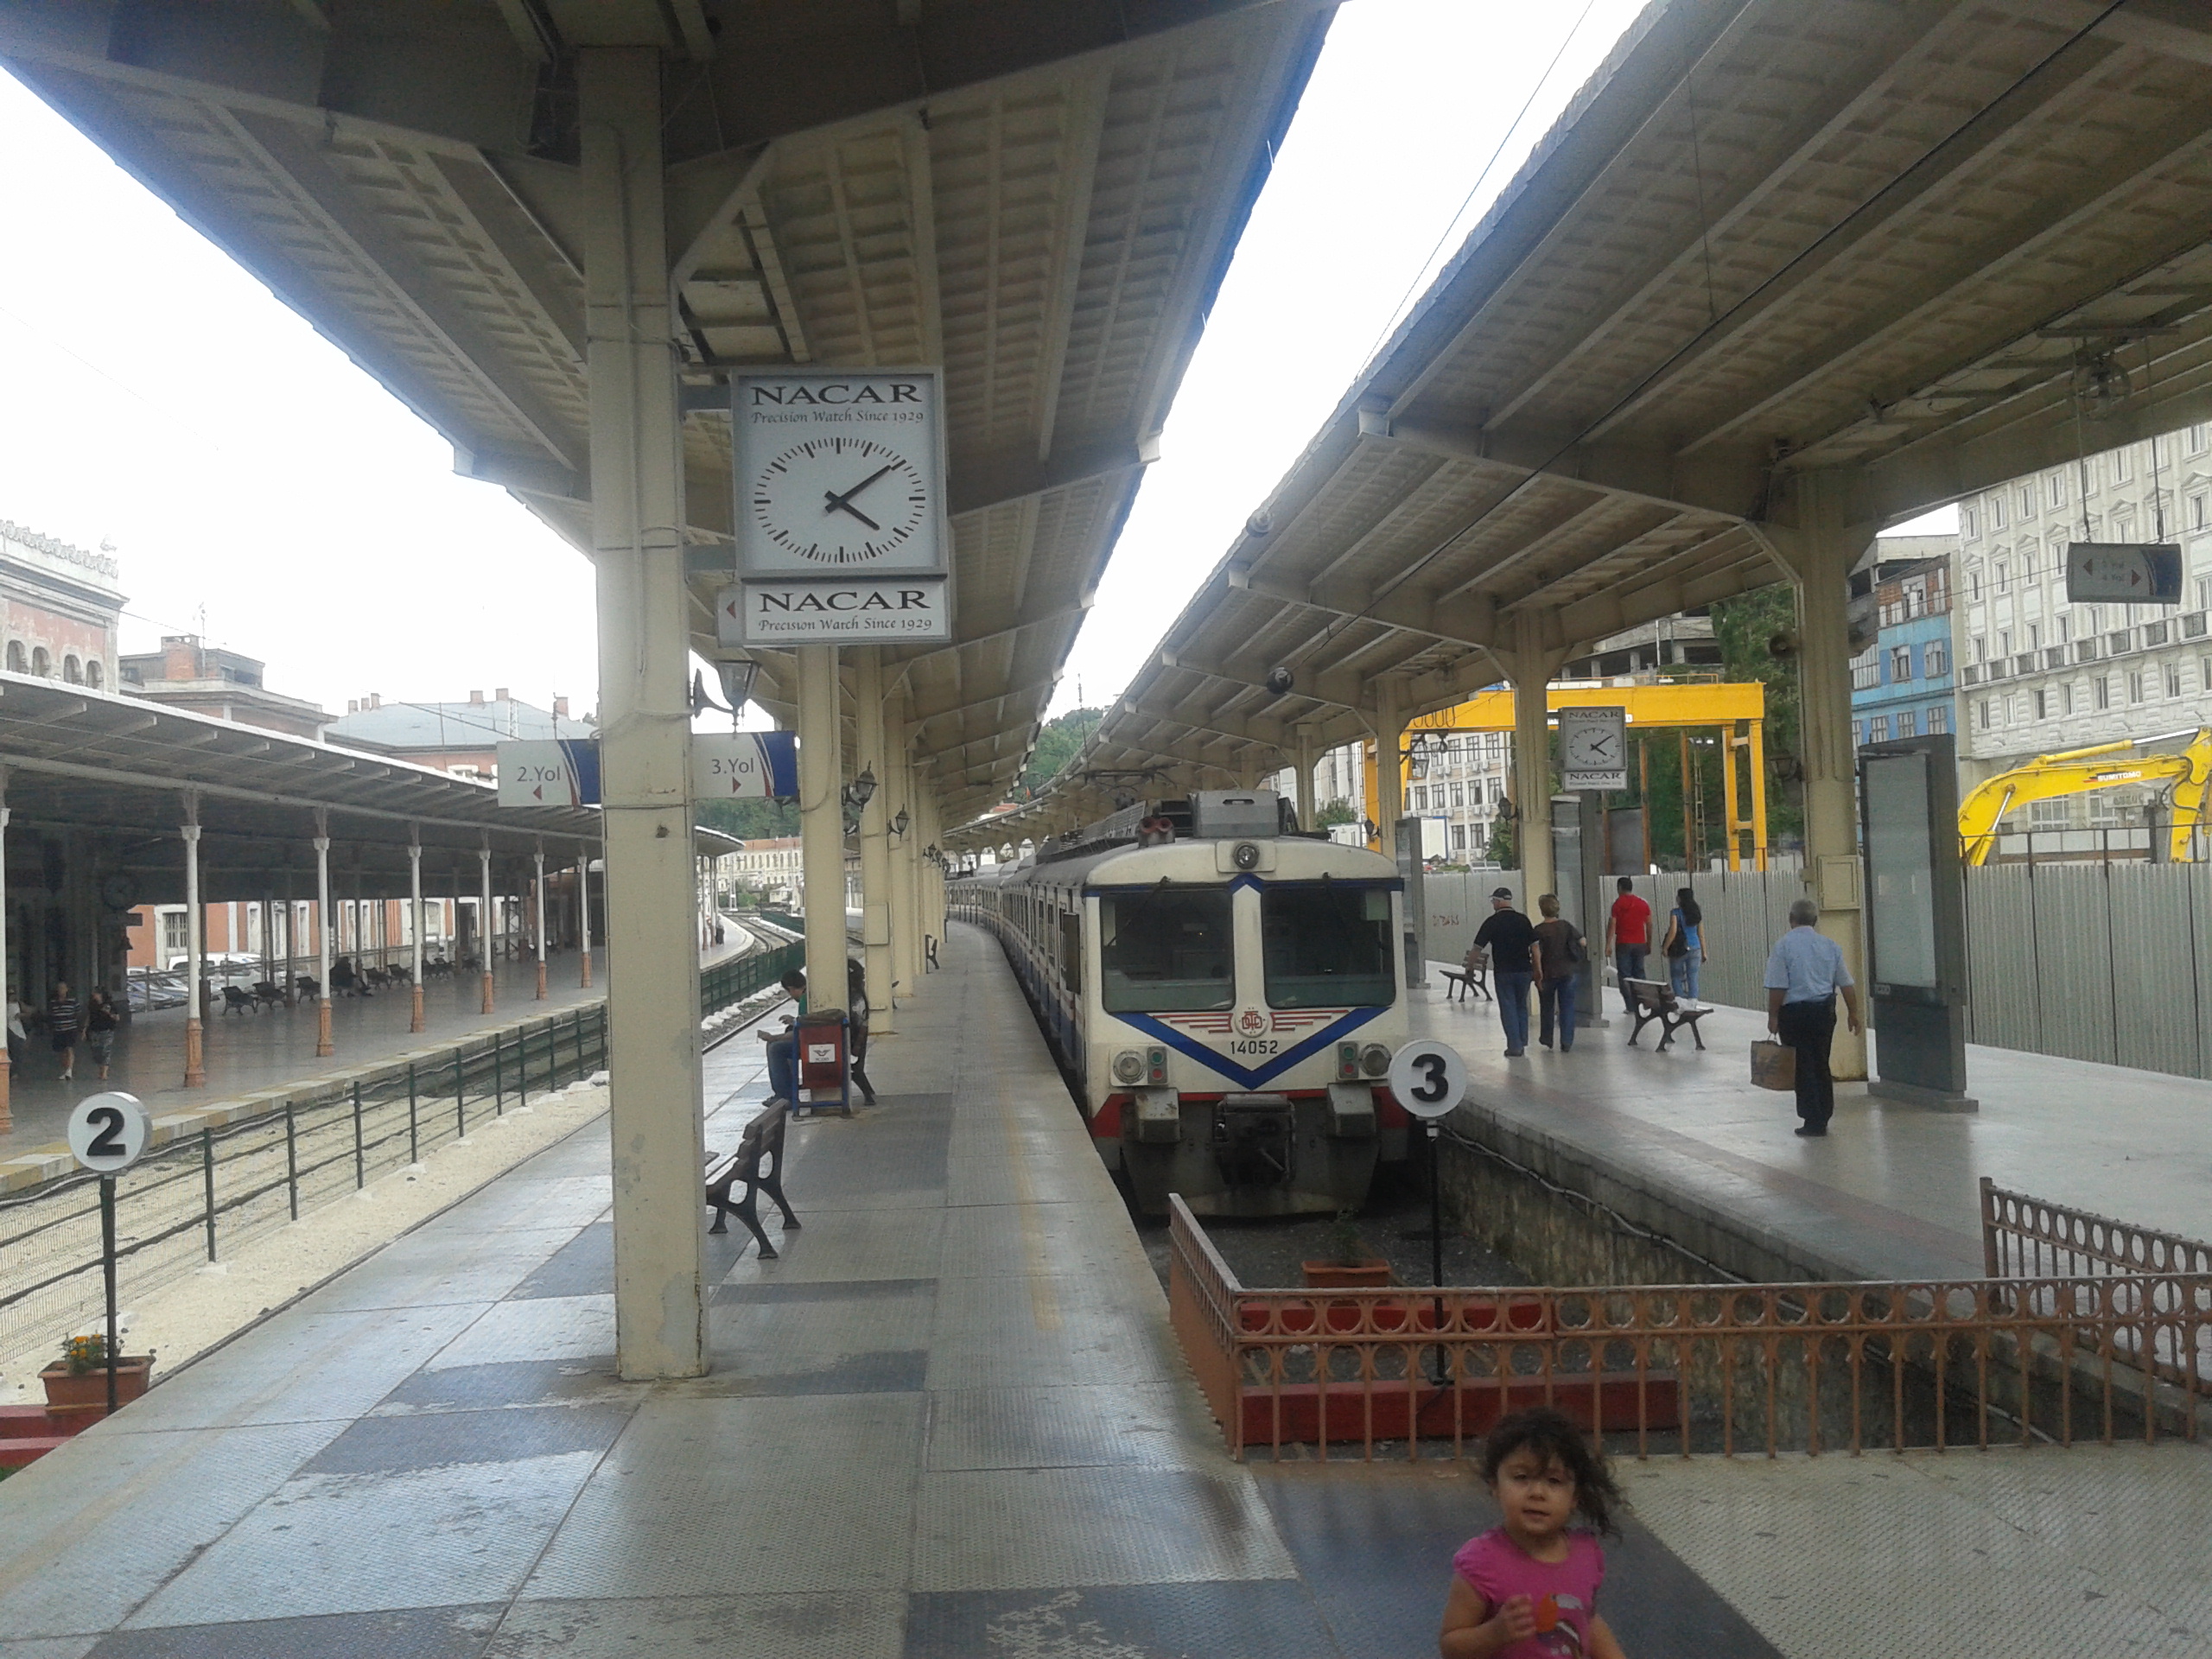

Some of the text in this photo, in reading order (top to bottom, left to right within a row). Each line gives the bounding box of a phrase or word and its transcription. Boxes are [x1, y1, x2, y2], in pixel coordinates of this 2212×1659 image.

[750, 384, 923, 406] NACAR
[751, 407, 925, 424] Precision Watch Since 1929
[759, 590, 931, 613] NACAR
[759, 614, 932, 632] Precision Watch Since 1929
[1568, 710, 1620, 719] NACAR
[517, 766, 561, 782] 2.Yol
[711, 757, 754, 774] 3.Yol
[1569, 772, 1622, 780] NACAR
[2097, 770, 2142, 782] SUMITOMO
[1230, 1039, 1279, 1055] 14052
[1410, 1052, 1449, 1103] 3
[86, 1107, 126, 1157] 2
